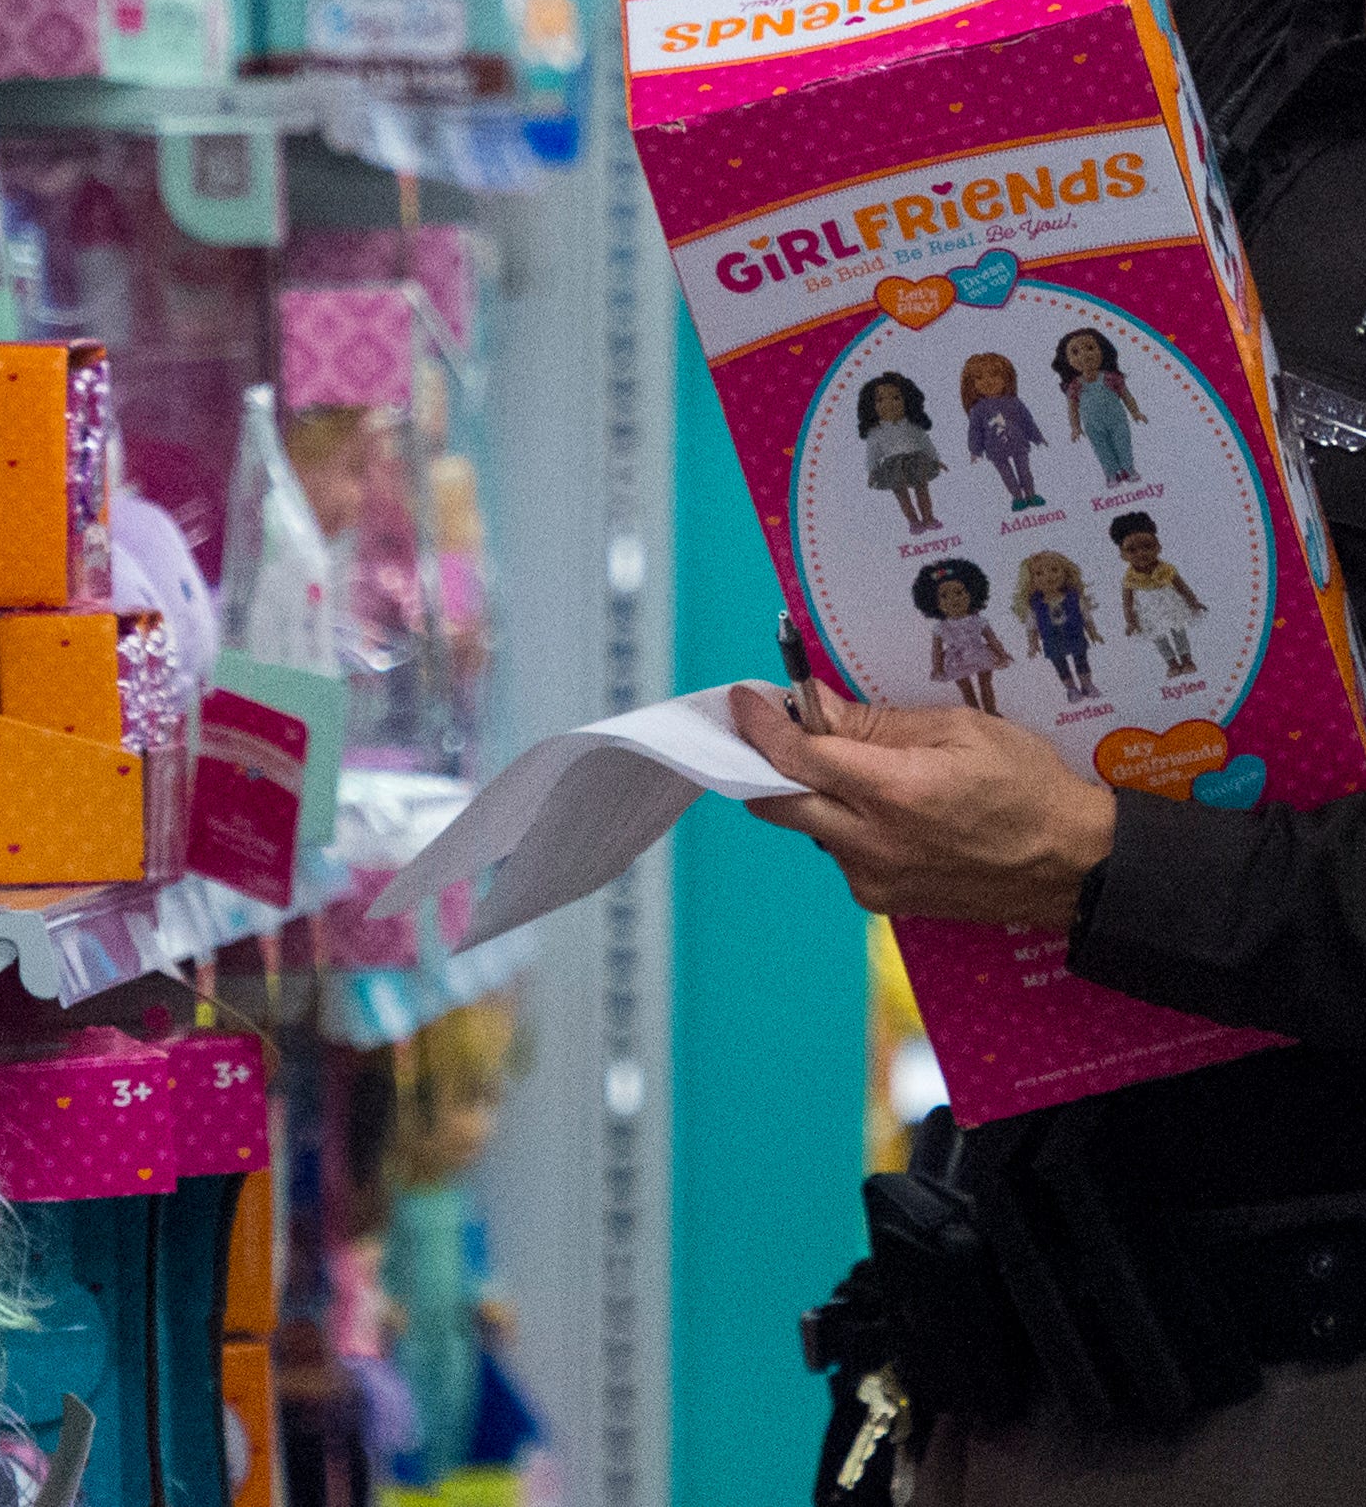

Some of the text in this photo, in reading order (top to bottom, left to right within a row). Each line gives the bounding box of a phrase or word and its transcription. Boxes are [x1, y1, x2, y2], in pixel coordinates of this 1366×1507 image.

[804, 275, 831, 293] Be
[894, 248, 923, 266] Be
[986, 224, 1016, 244] Be
[959, 261, 1007, 289] Dress
[1091, 483, 1165, 512] Kennedy
[999, 508, 1067, 536] Addison
[898, 534, 962, 558] Karsyn
[1161, 678, 1207, 701] Rylee
[1055, 702, 1114, 726] Jordan
[213, 1061, 251, 1089] 3+
[112, 1079, 153, 1107] 3+
